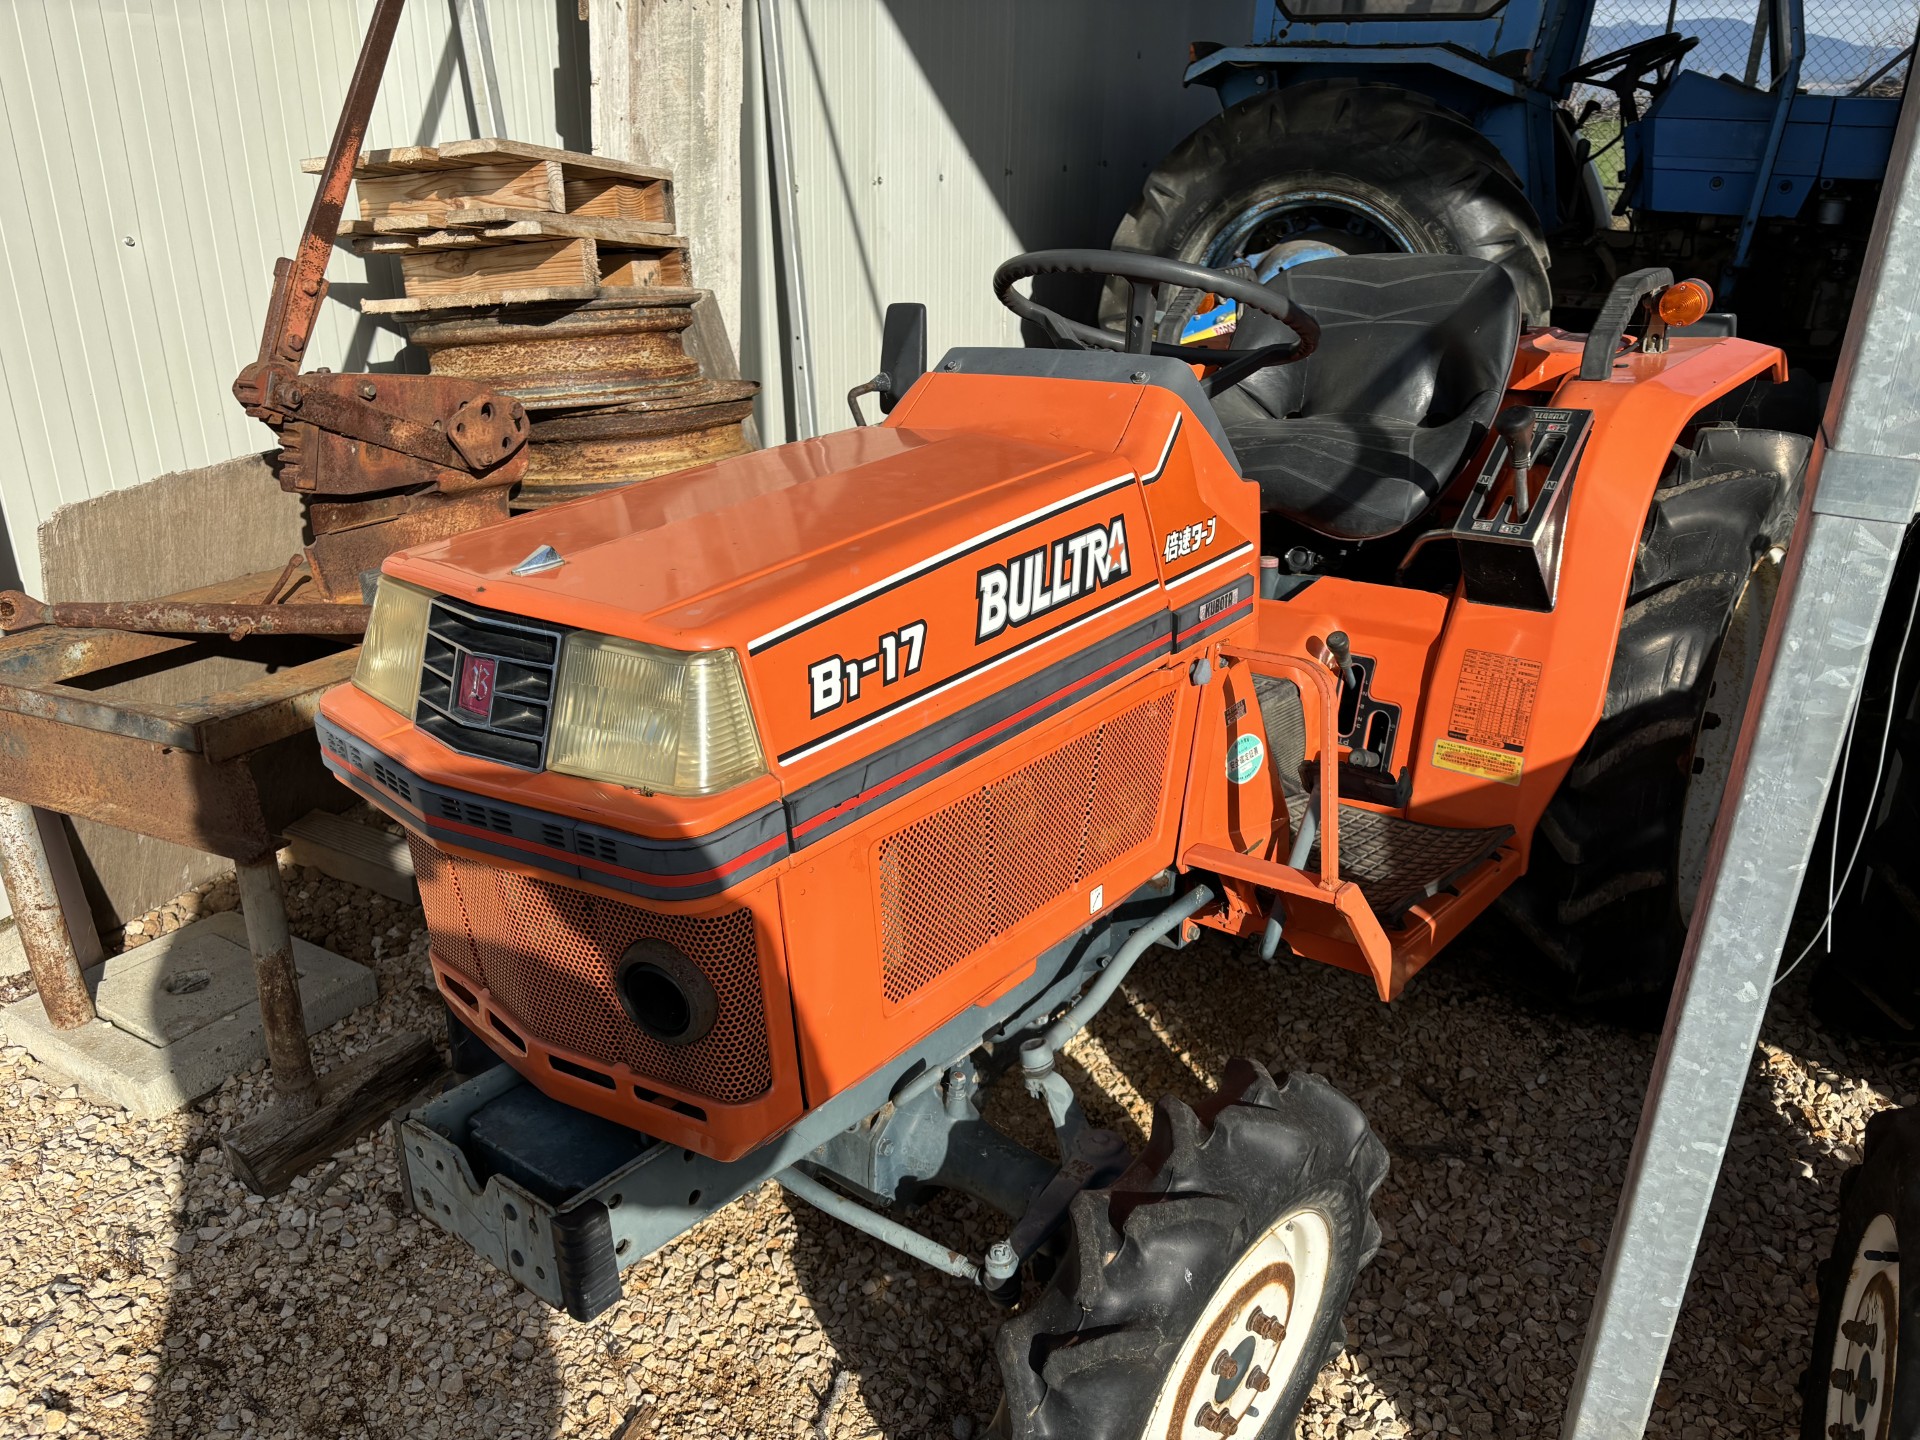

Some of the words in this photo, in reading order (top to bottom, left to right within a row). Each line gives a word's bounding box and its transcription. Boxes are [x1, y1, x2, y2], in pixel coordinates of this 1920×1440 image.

[1163, 516, 1217, 563] 倍速ターン
[977, 517, 1129, 641] BULLTRA
[1204, 591, 1234, 619] KUBOTA
